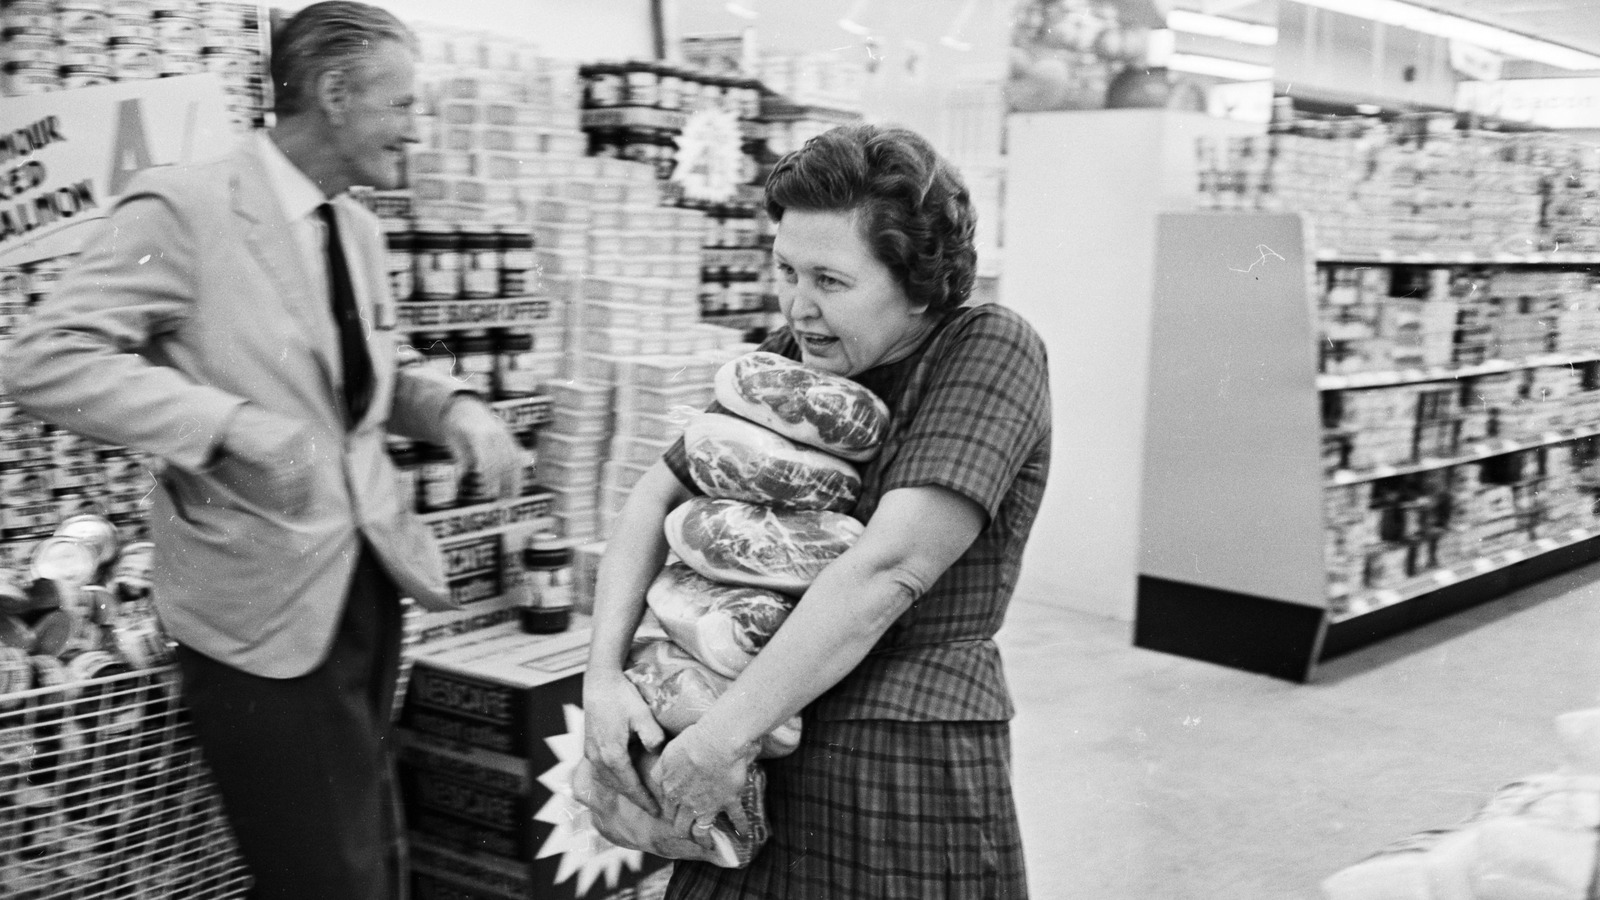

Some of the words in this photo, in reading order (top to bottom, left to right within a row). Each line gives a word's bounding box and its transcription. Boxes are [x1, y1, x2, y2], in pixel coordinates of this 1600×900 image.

[0, 179, 98, 242] ALMON
[444, 302, 502, 324] SUGAR
[504, 300, 552, 321] OFFER
[506, 401, 553, 425] OFFER
[449, 508, 504, 537] SUGAR
[507, 498, 555, 523] OFFER
